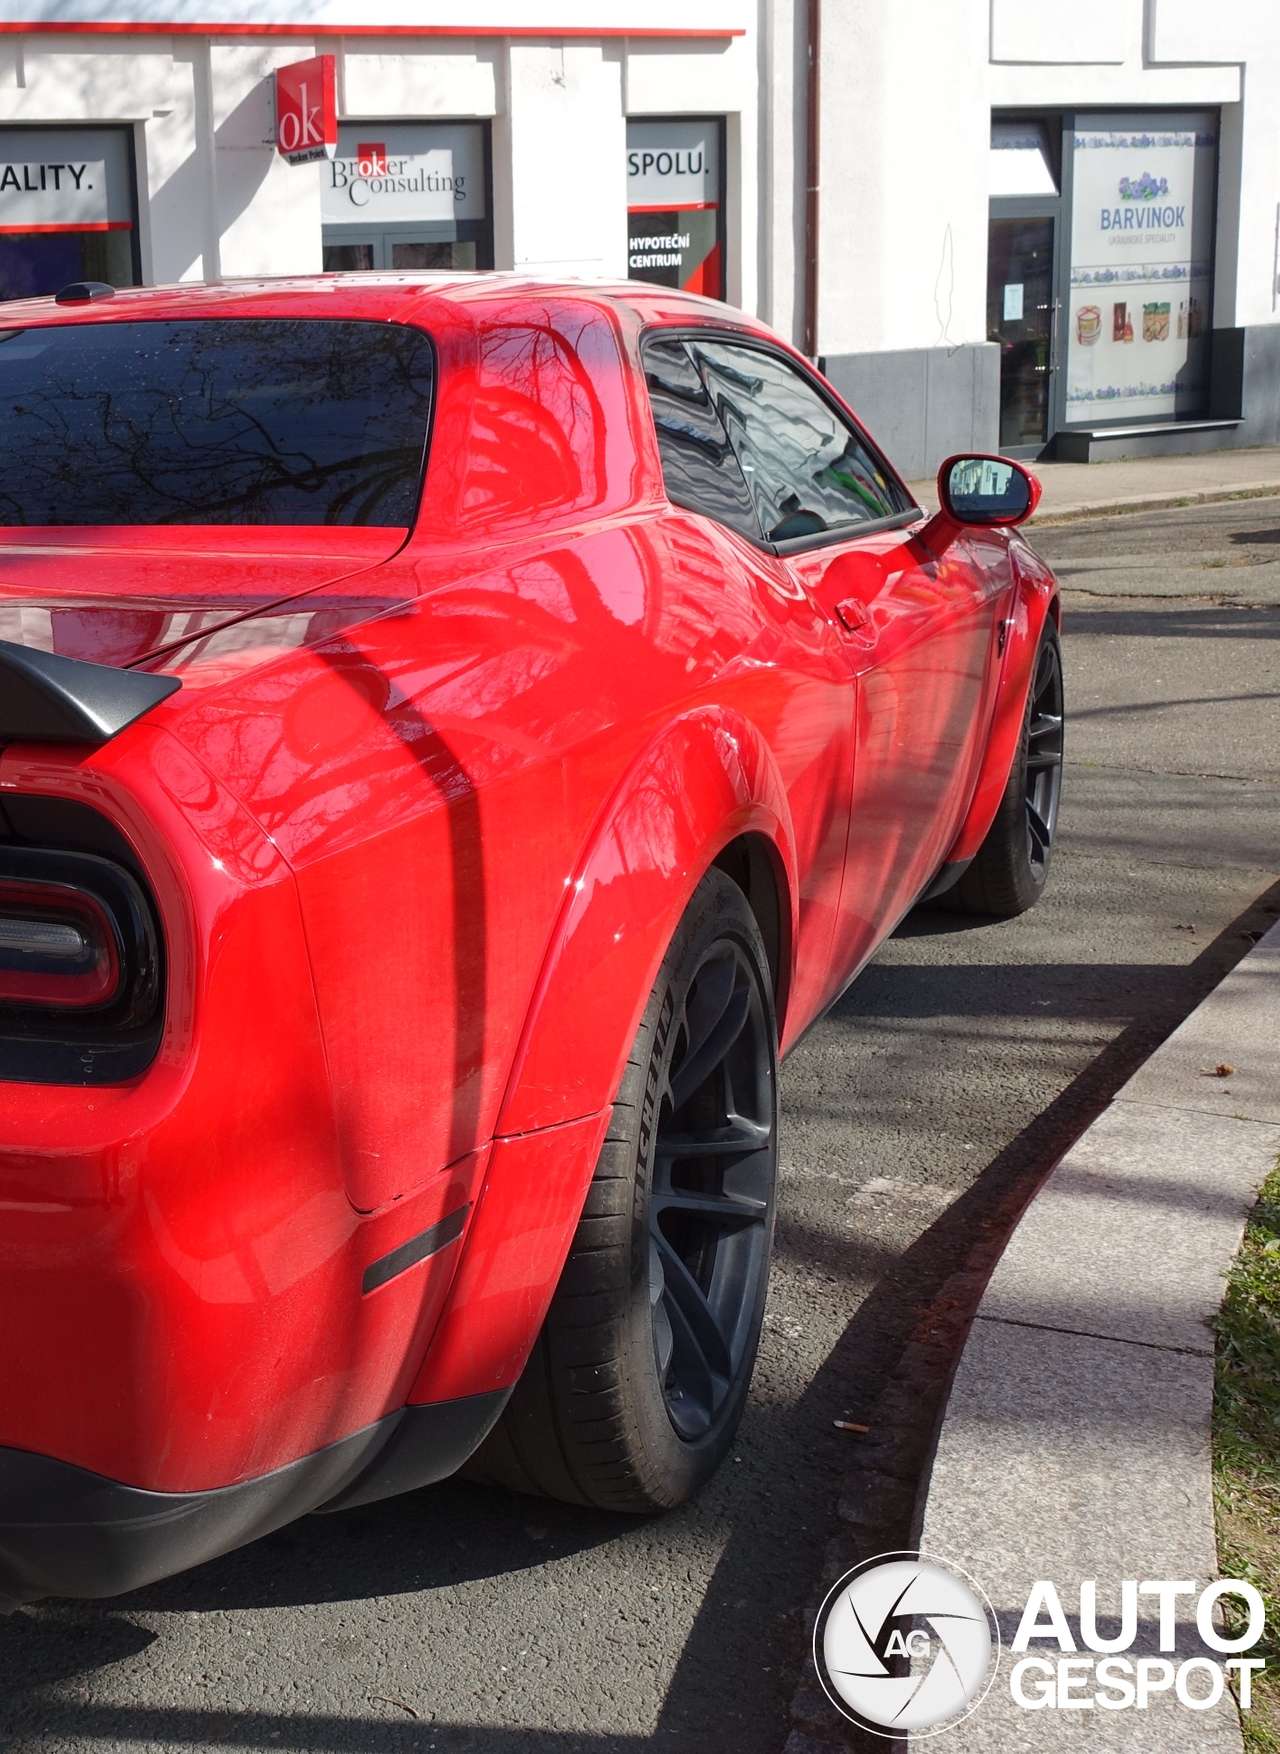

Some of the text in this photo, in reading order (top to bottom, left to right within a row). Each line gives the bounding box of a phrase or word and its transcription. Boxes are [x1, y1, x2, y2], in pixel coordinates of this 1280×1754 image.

[279, 82, 323, 150] ok
[628, 151, 710, 176] SPOLU.
[349, 168, 467, 207] Consulting
[1100, 206, 1186, 231] BARVINOK
[629, 233, 691, 250] HYPOTEČNÍ
[629, 253, 682, 268] CENTRUM
